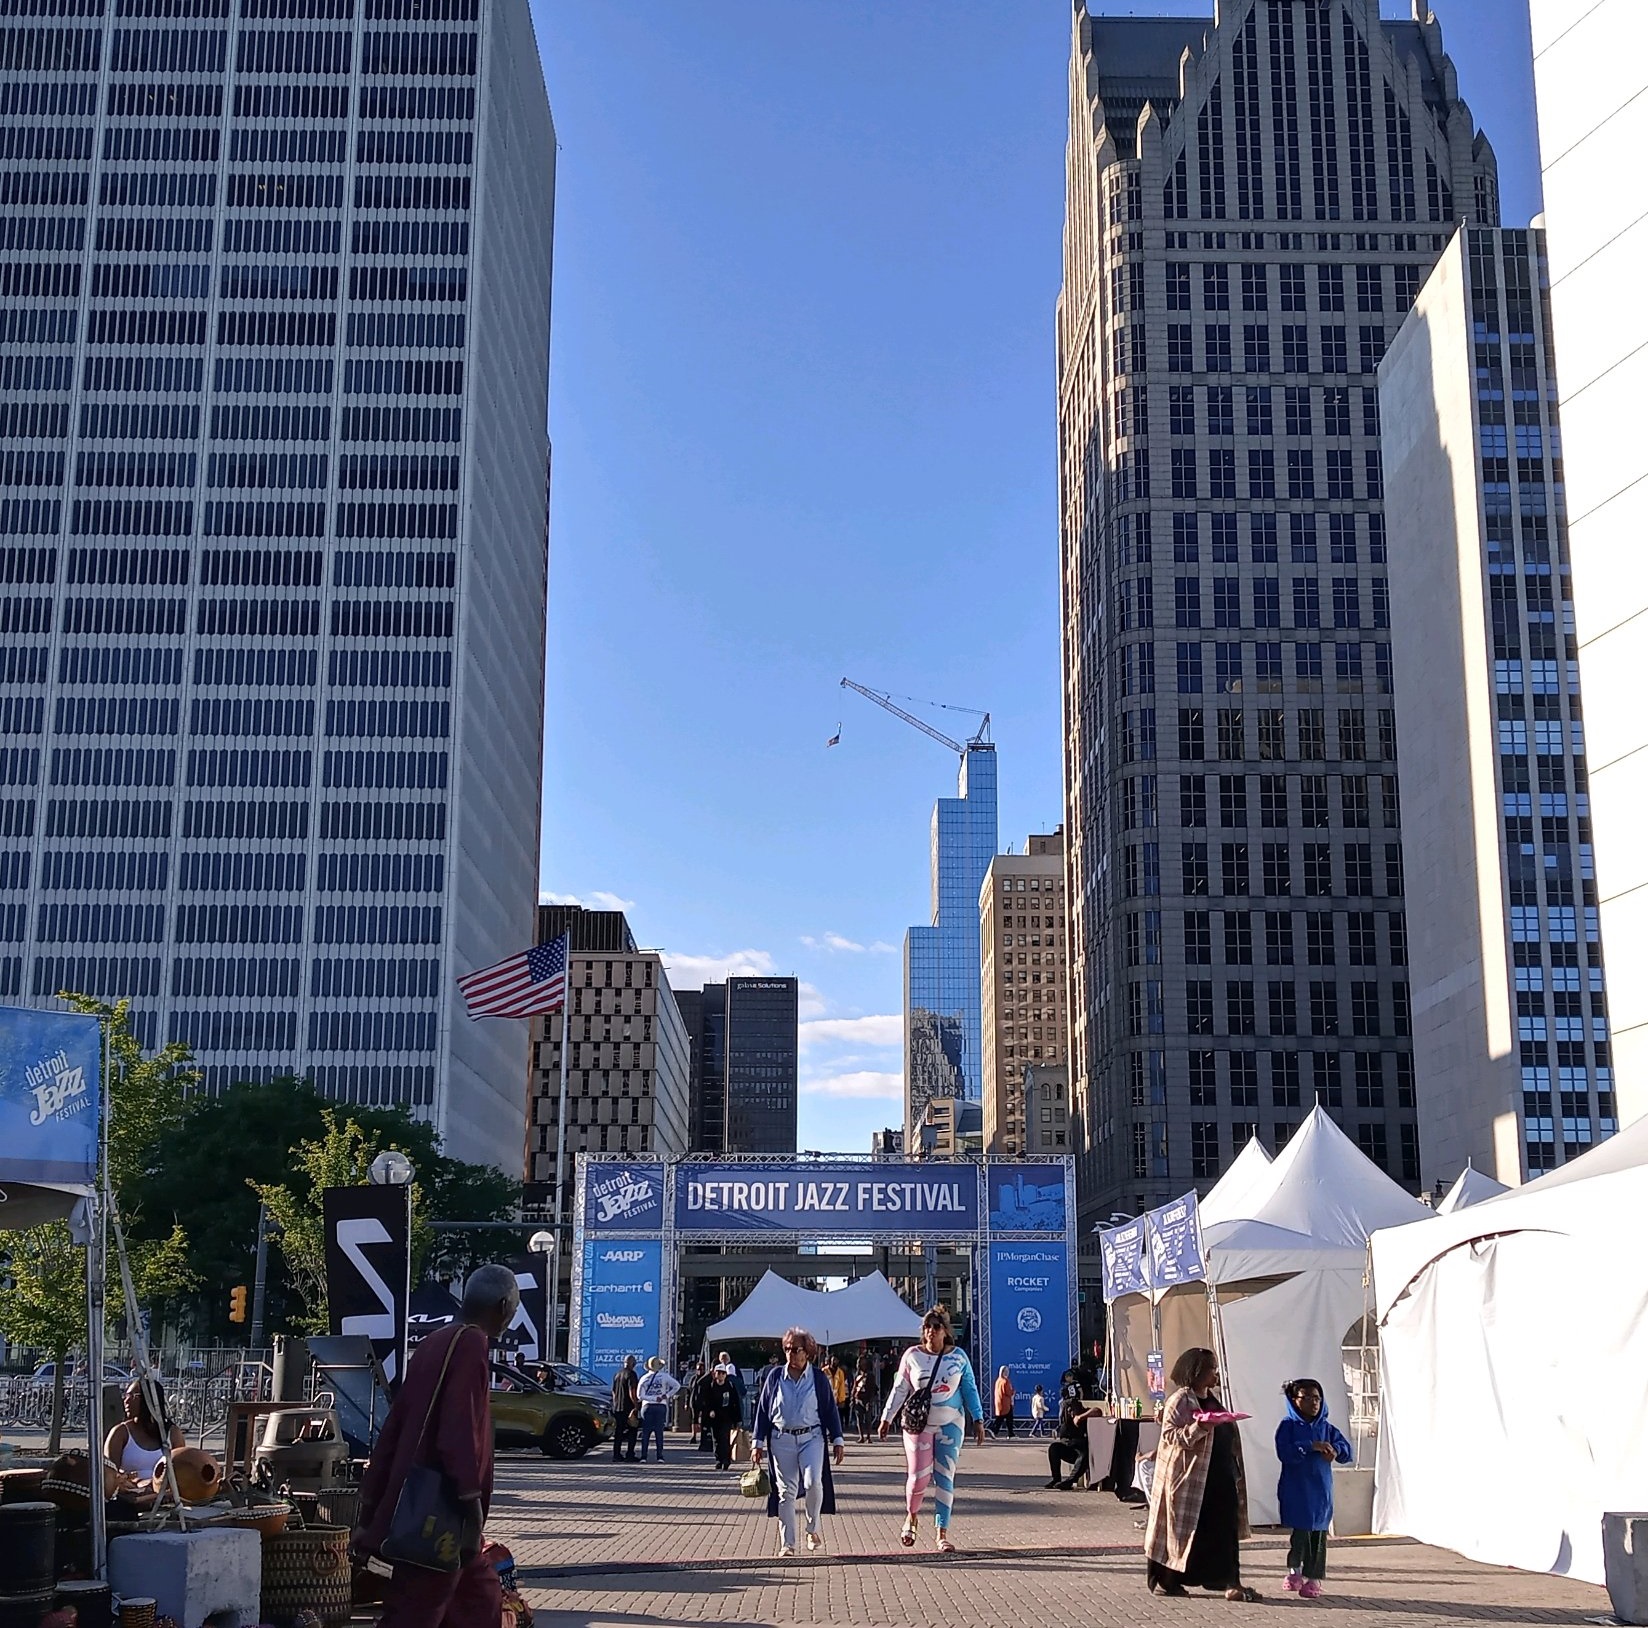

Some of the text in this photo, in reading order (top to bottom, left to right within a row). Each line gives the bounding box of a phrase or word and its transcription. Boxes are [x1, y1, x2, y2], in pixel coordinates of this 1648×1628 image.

[25, 1050, 69, 1087] detroit
[28, 1066, 86, 1126] Jazz
[55, 1097, 92, 1123] FESTIVAL
[593, 1171, 633, 1197] detroit
[597, 1180, 654, 1222] Jazz
[687, 1182, 966, 1212] DETROIT JAZZ FESTIVAL
[623, 1199, 658, 1219] FESTIVAL
[600, 1250, 644, 1261] AARP
[997, 1252, 1060, 1262] JPMorganChase
[588, 1284, 643, 1293] carhartt
[1007, 1277, 1050, 1286] ROCKET
[595, 1354, 644, 1362] JAZZ CEER
[1027, 1362, 1051, 1370] avenue
